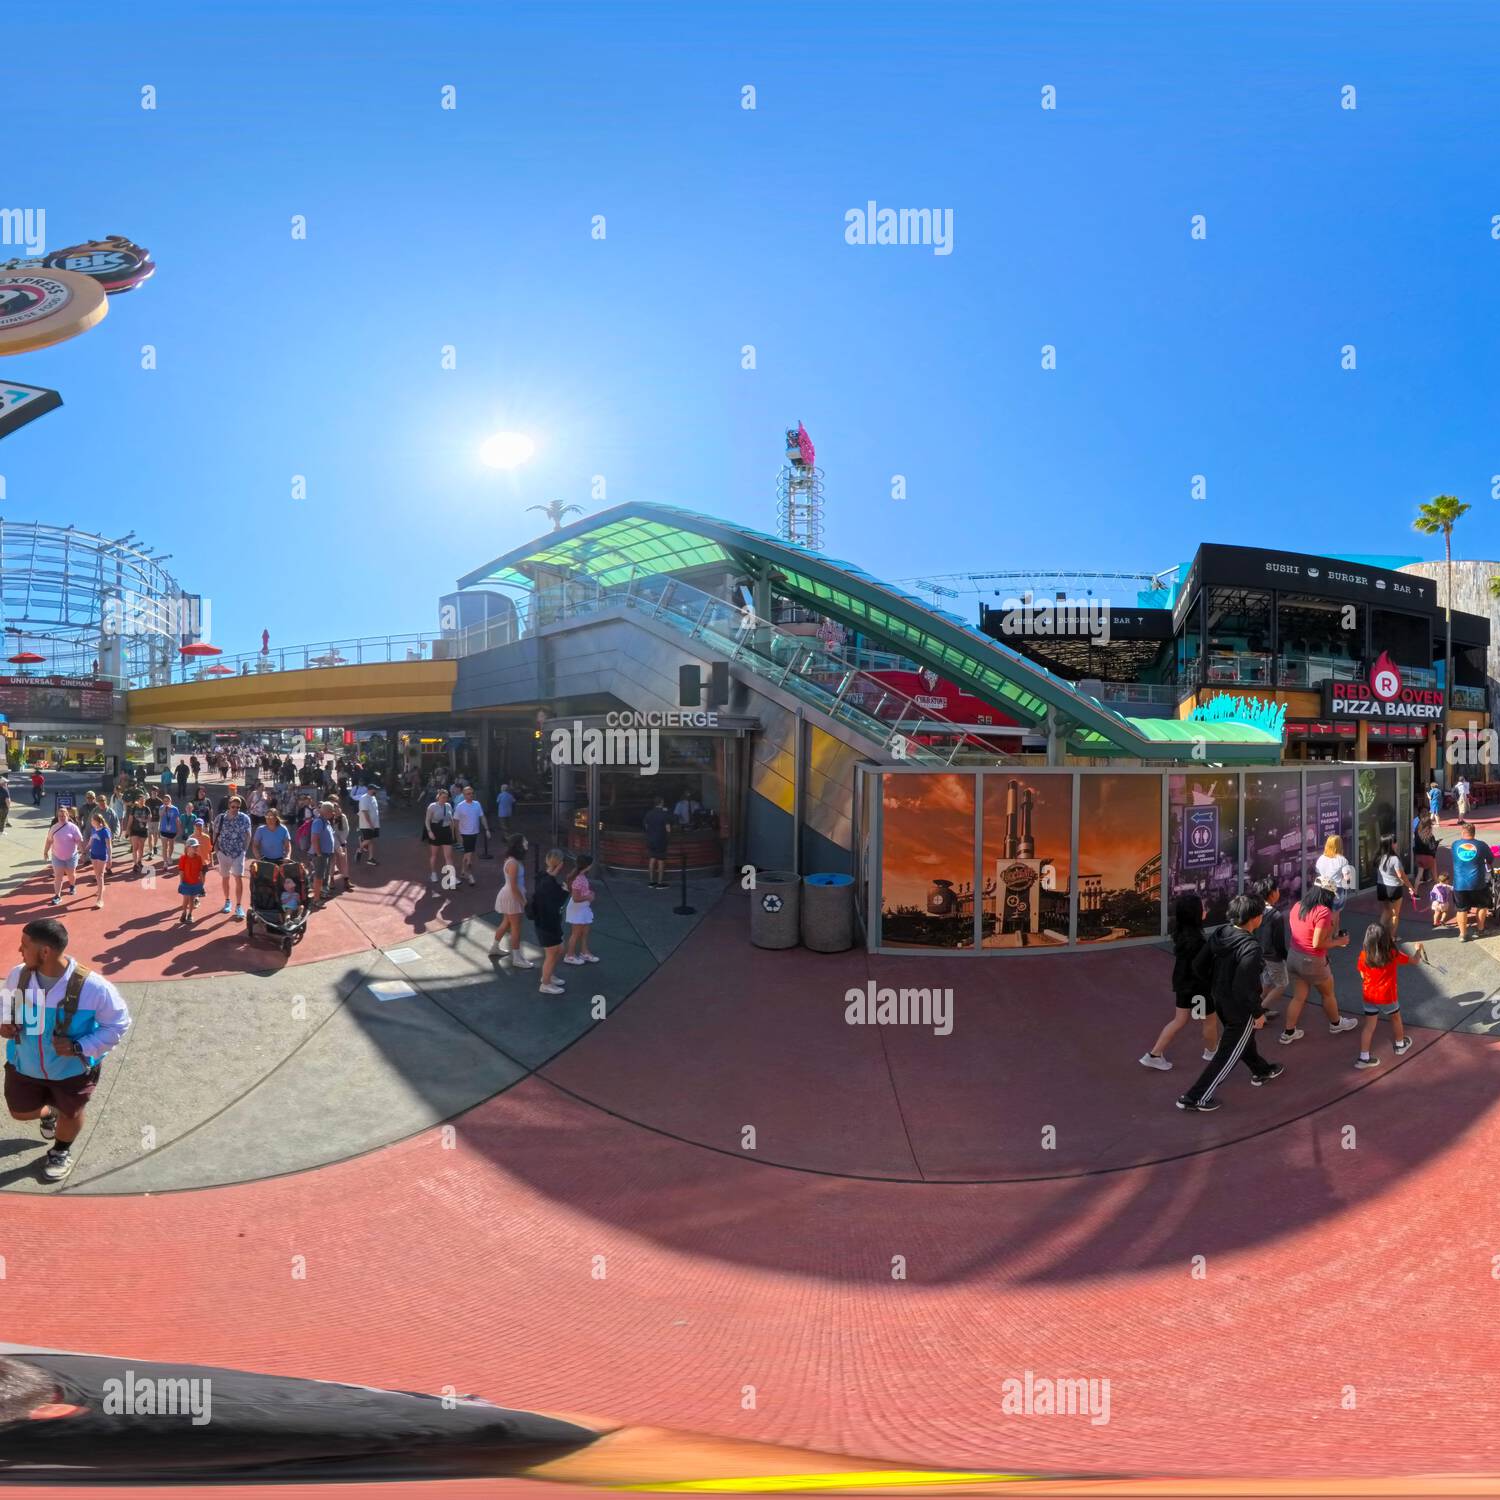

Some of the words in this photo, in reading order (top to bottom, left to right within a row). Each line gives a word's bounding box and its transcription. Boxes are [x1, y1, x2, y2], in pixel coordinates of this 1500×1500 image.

[65, 251, 125, 270] BK
[1265, 562, 1299, 574] SUSHI
[1328, 571, 1369, 585] BURGER
[1393, 582, 1412, 594] BAR
[1113, 616, 1131, 625] BAR
[10, 677, 55, 686] UNIVERSAL
[1333, 683, 1370, 700] RED
[1401, 688, 1444, 705] OVEN
[1332, 699, 1381, 715] PIZZA
[1385, 702, 1443, 718] BAKERY
[606, 711, 719, 727] CONCIERGE
